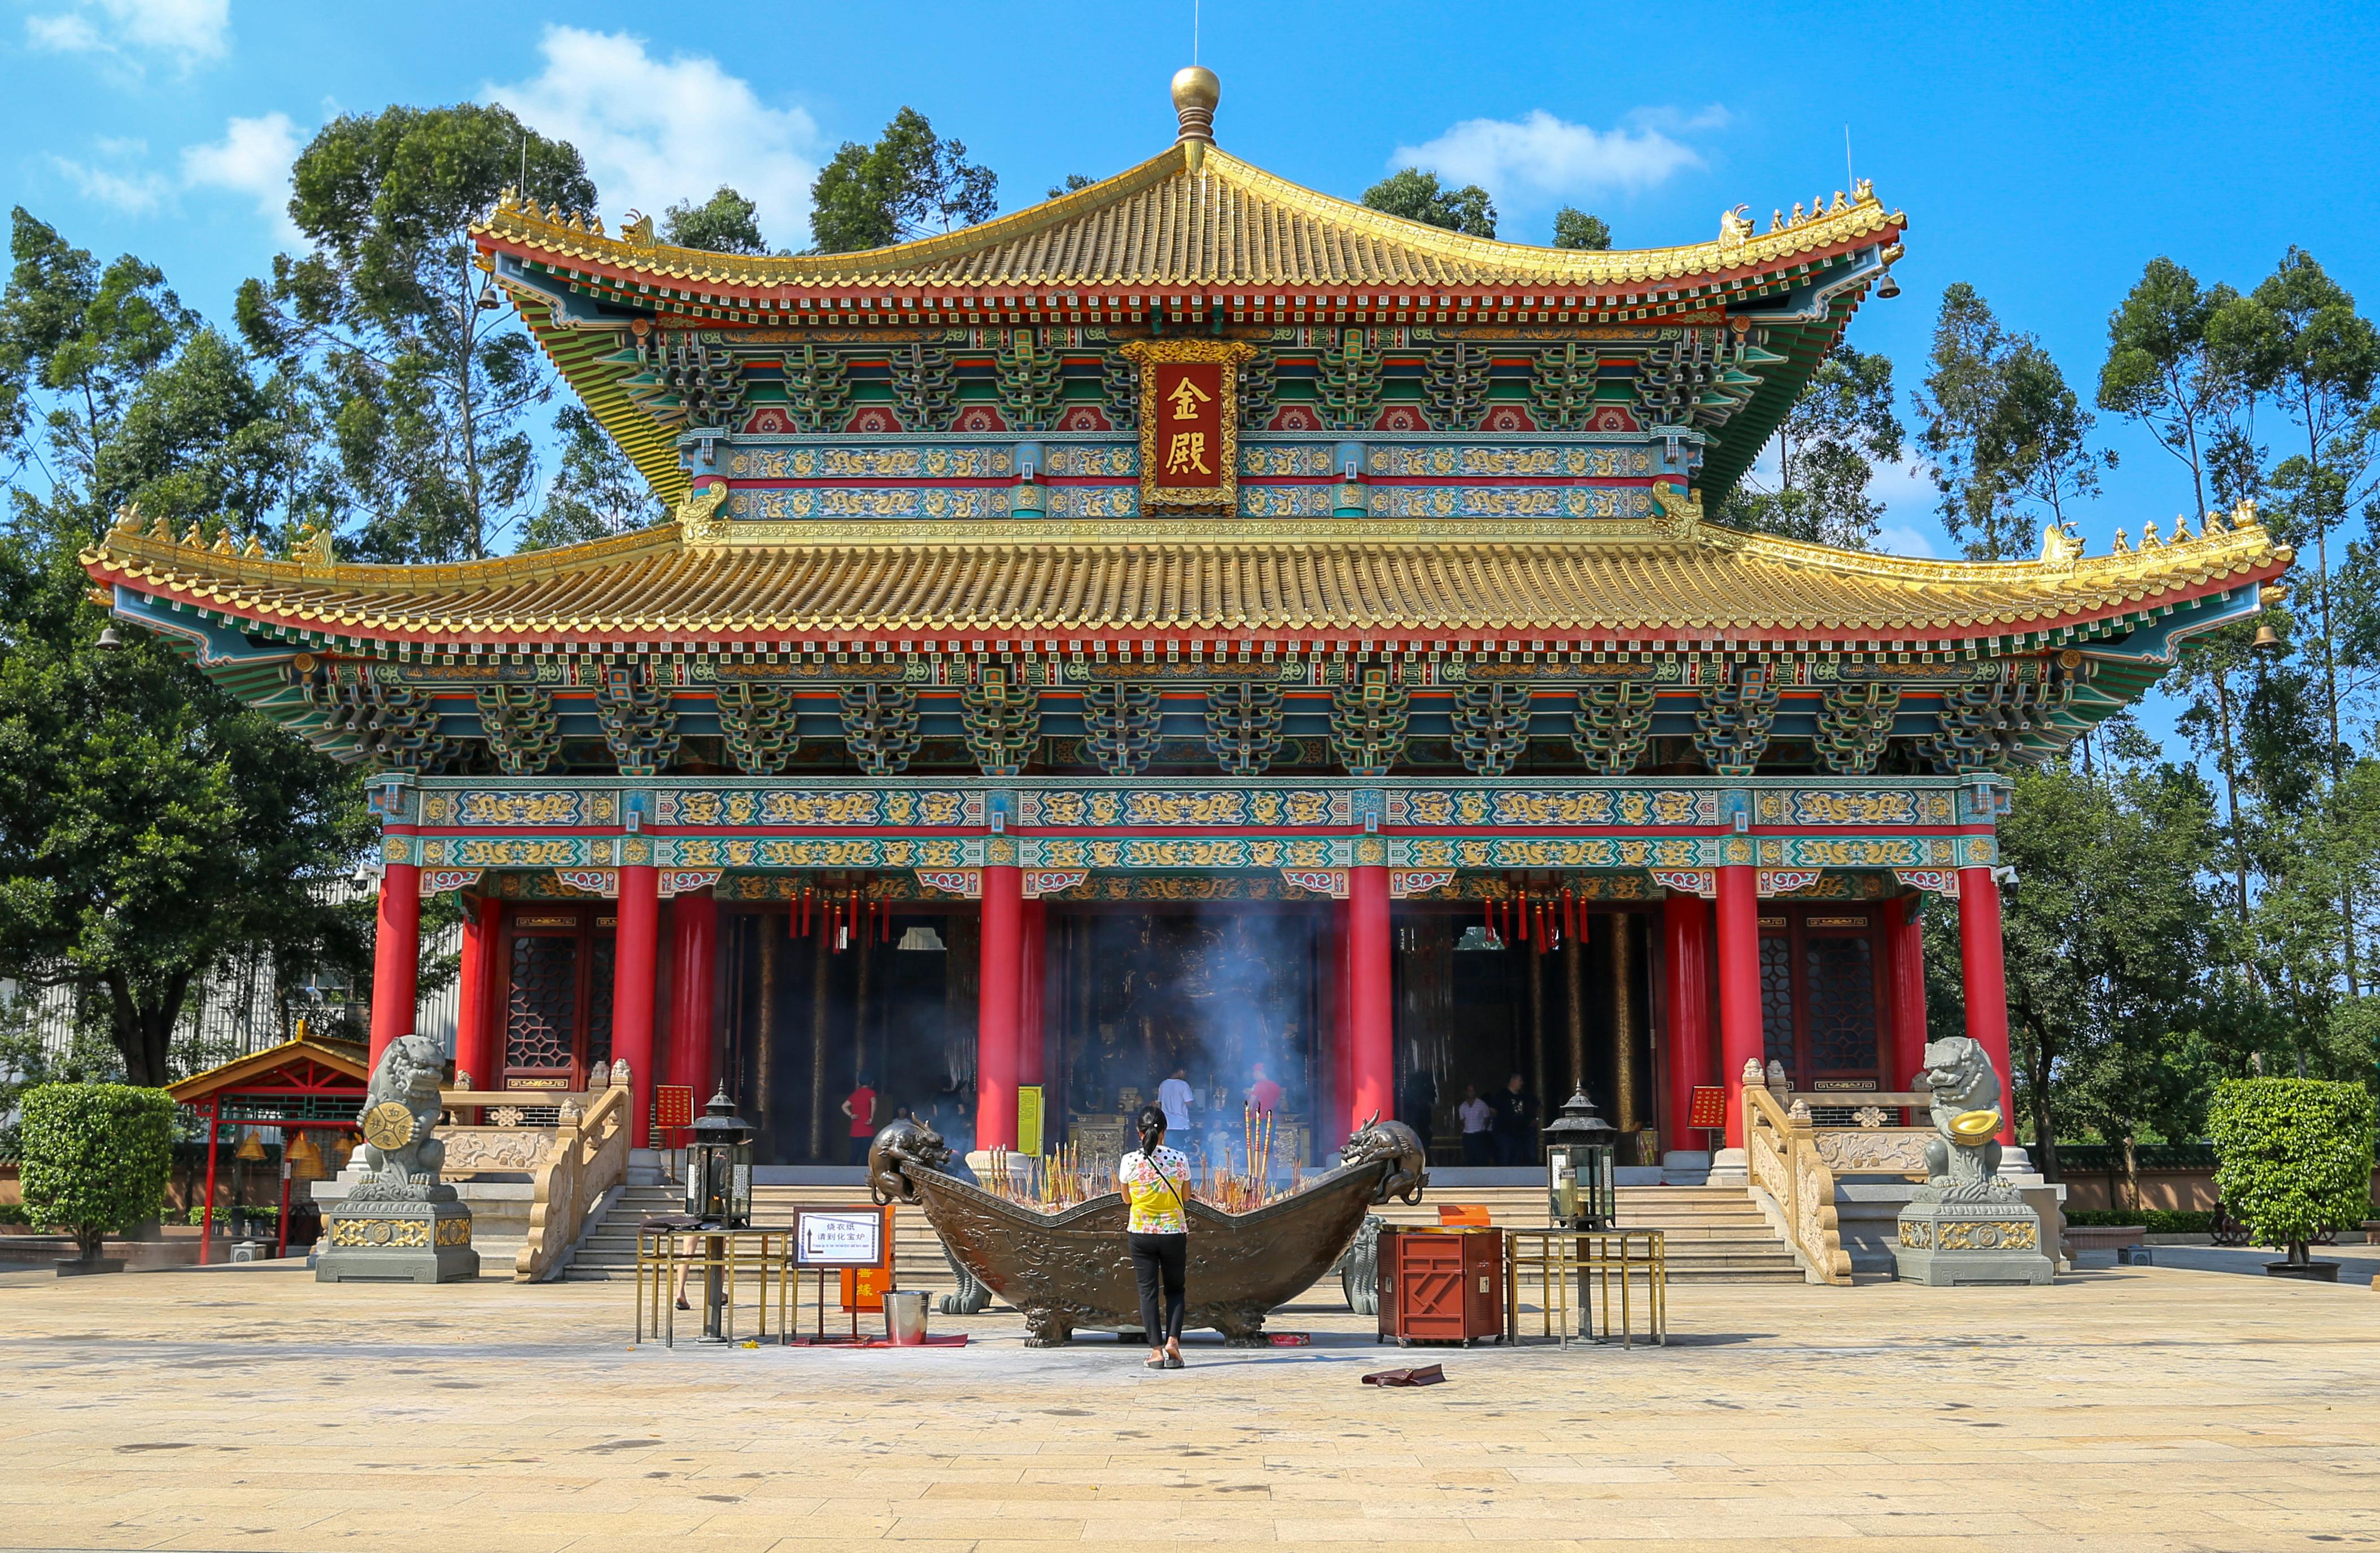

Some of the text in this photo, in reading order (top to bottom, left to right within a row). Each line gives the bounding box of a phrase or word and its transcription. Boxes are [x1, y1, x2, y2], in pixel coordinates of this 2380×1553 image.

[1165, 377, 1212, 475] 金殿
[388, 1107, 399, 1116] 如
[826, 1223, 855, 1231] 烧衣纸
